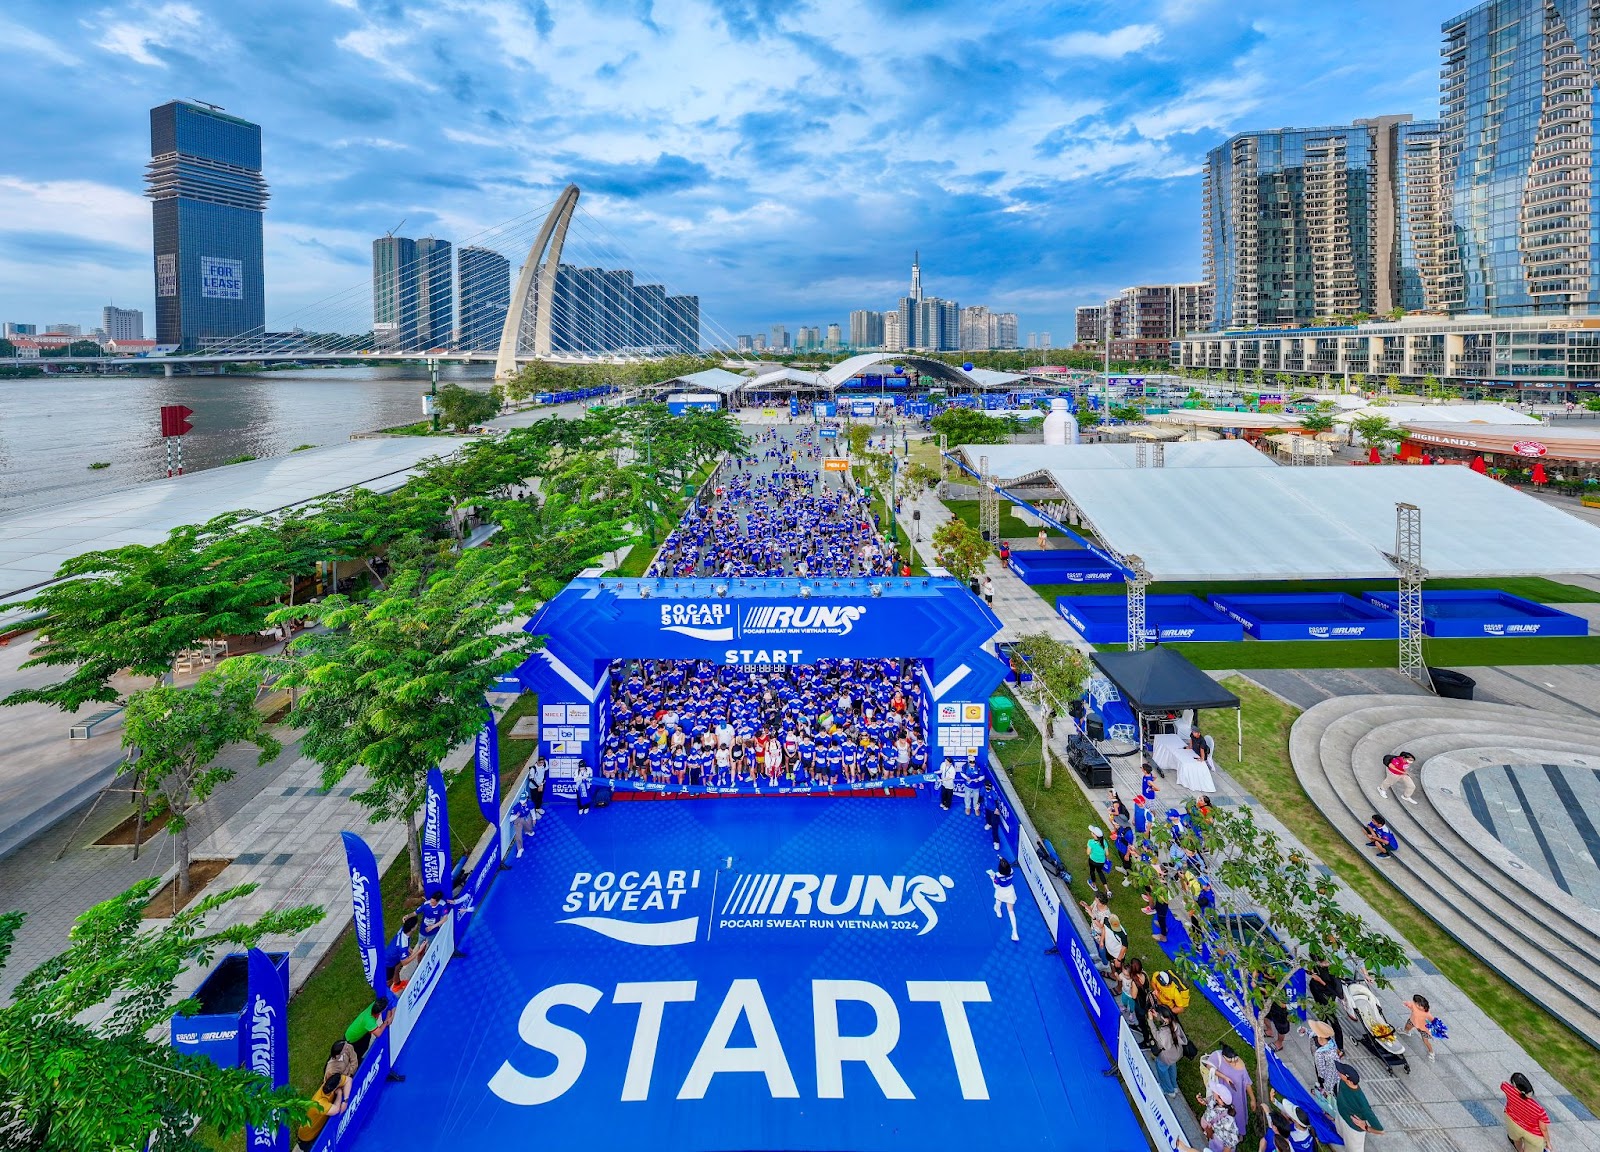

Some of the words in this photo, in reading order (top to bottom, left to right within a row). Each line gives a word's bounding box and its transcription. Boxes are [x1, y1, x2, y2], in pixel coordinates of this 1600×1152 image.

[210, 265, 232, 277] FOR
[204, 277, 240, 290] LEASE
[1411, 432, 1477, 447] HIGHLANDS
[661, 604, 731, 615] POCARI
[661, 614, 724, 625] SWEAT
[725, 650, 803, 663] START
[424, 852, 432, 884] POCARI
[430, 855, 438, 883] SWEAT
[570, 869, 700, 891] POCARI
[562, 890, 686, 913] SWEAT
[720, 919, 764, 929] POCARI
[766, 919, 807, 928] SWEAT
[809, 920, 834, 928] RUN
[836, 920, 889, 929] VIETNAM
[891, 921, 919, 930] 2024
[487, 978, 992, 1106] START
